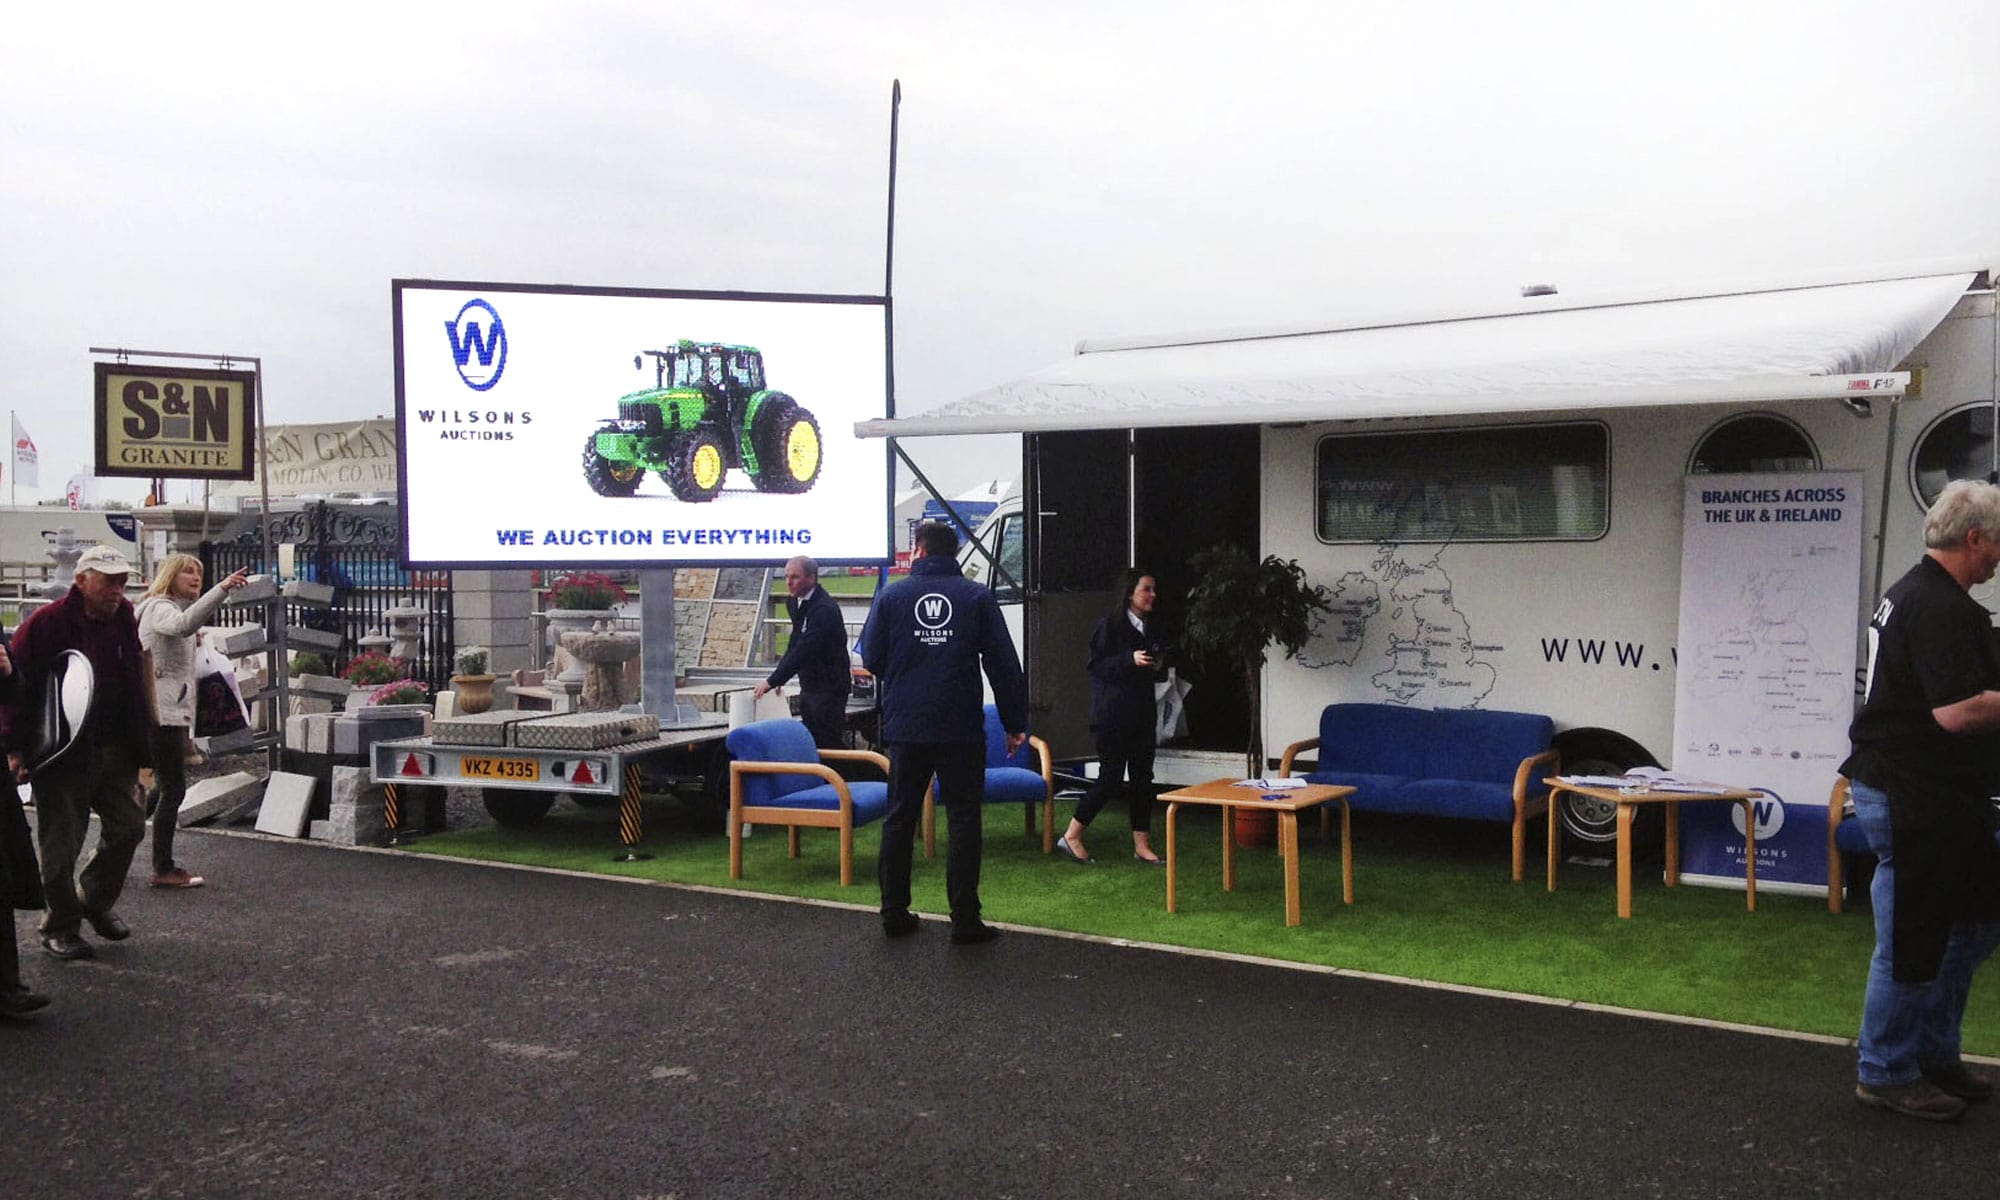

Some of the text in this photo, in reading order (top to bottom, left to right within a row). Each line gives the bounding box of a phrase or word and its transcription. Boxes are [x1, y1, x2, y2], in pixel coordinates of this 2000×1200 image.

[122, 380, 229, 442] S&N
[418, 410, 532, 424] WILSONS
[440, 430, 514, 440] AUCTIONS
[121, 447, 229, 466] GRANITE
[1701, 488, 1846, 504] BRANCHES ACROSS
[1704, 508, 1841, 523] THE UK & IRELAND
[497, 529, 812, 545] WE AUCTION EVERYTHING
[464, 758, 533, 777] VKZ 4335
